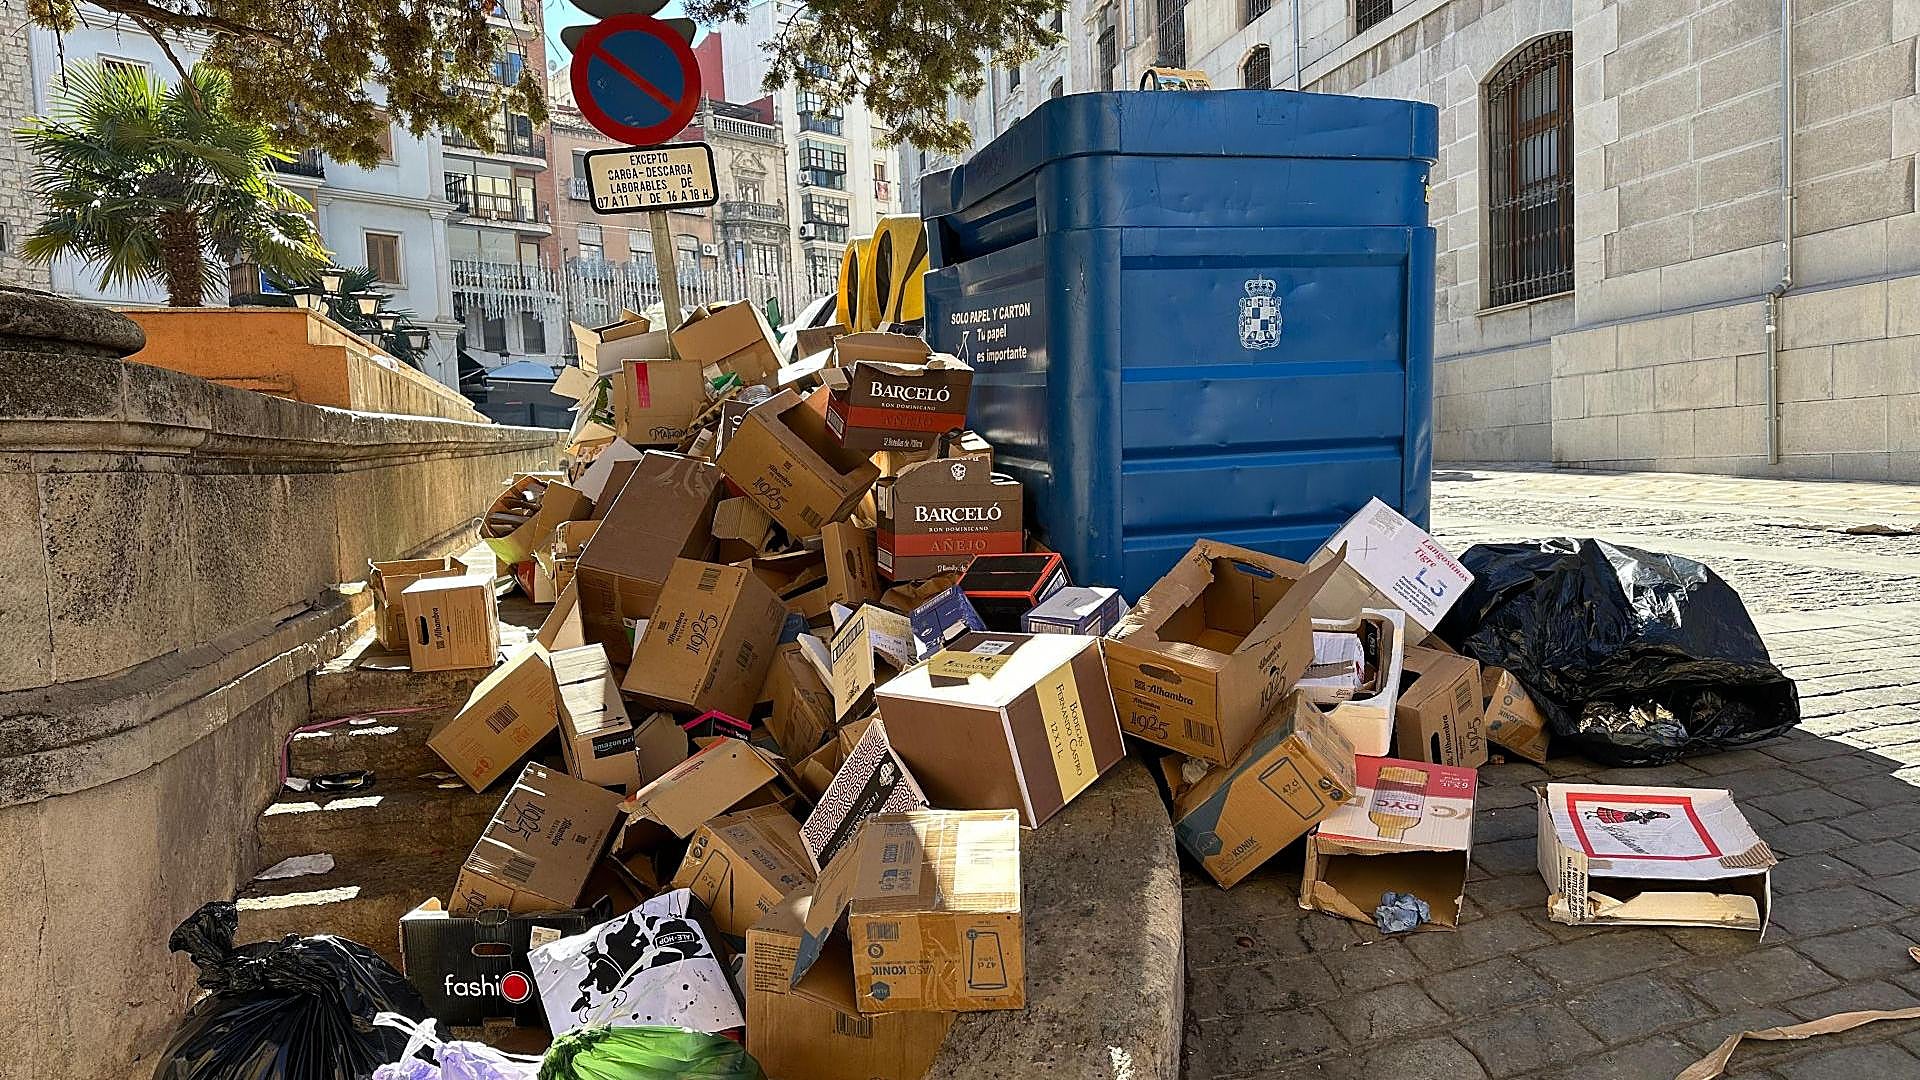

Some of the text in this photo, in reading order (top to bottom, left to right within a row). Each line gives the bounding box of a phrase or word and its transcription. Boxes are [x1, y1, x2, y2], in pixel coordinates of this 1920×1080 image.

[629, 152, 668, 166] EXCEPTO
[610, 177, 693, 195] LABORABLES DE
[597, 196, 608, 209] 07
[636, 193, 642, 205] Y
[649, 192, 661, 204] DE
[667, 190, 677, 202] 16
[689, 188, 700, 201] 18
[951, 302, 1031, 325] SOLO PAPEL Y CARTON
[976, 323, 1007, 343] Tu papel
[976, 345, 1027, 365] es importante
[870, 381, 950, 402] BARCELÓ
[752, 476, 788, 511] 1925
[914, 502, 1002, 524] BARCELÓ
[930, 538, 987, 552] AÑEJO
[1414, 547, 1438, 568] Tigre
[1421, 538, 1469, 582] Langostinos
[432, 607, 442, 638] Alhambra
[667, 610, 686, 646] Alhambra
[686, 609, 718, 656] 1925
[1146, 684, 1195, 706] Alhambra
[1055, 683, 1083, 777] FERNANDO CASTRO
[1069, 700, 1084, 747] BODEGAS
[1130, 711, 1171, 741] 1925
[1443, 714, 1453, 755] Alhambra
[592, 736, 634, 752] amazon pri
[1466, 716, 1481, 754] 1925
[1375, 799, 1420, 811] DYC
[513, 801, 546, 842] 1925
[1231, 836, 1258, 857] KONIK
[871, 964, 907, 976] KONIK
